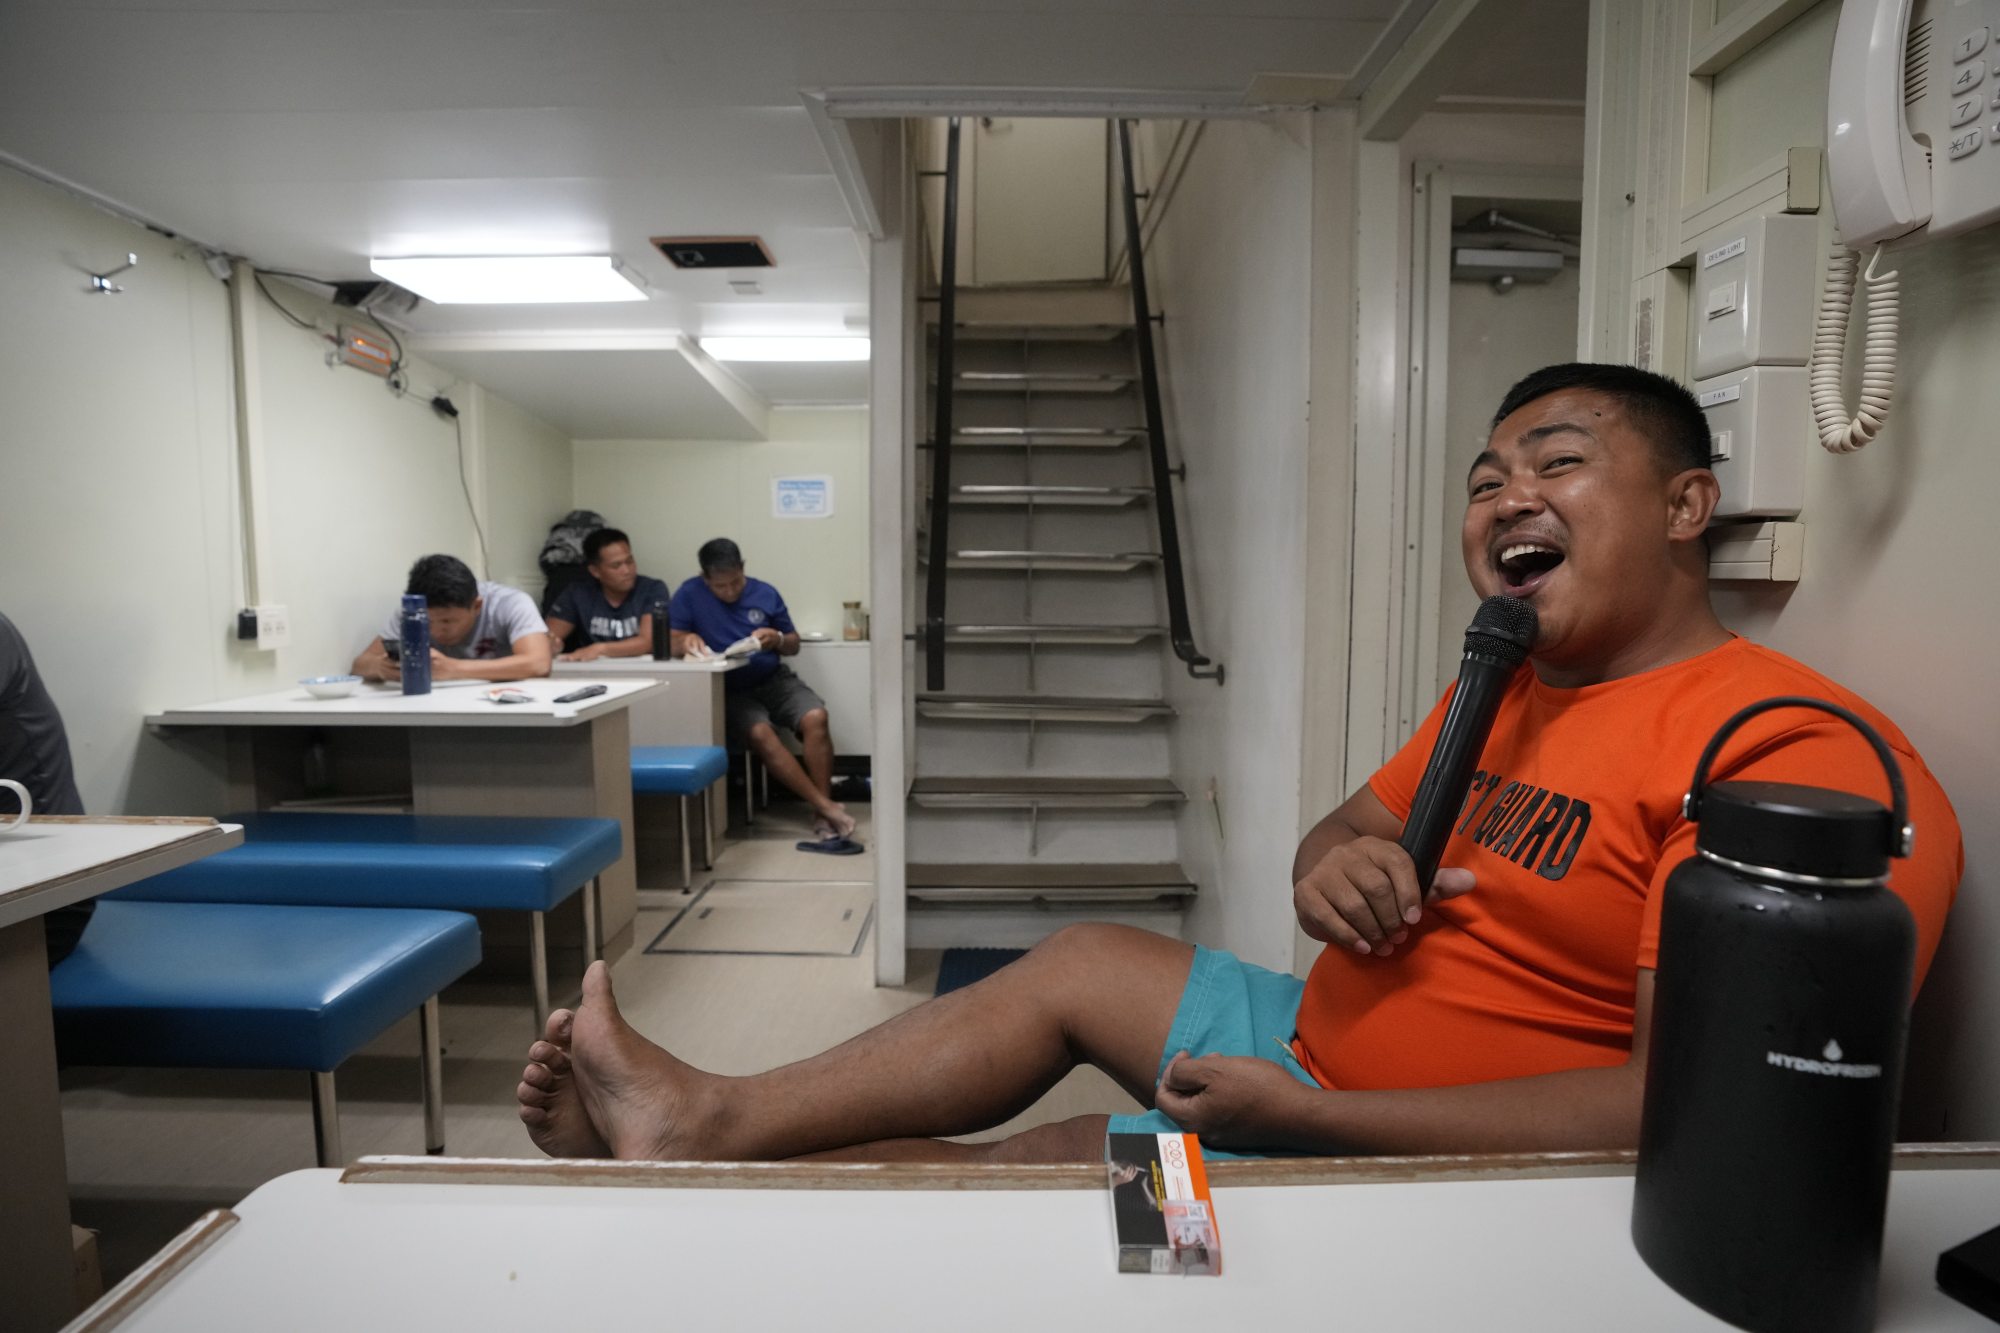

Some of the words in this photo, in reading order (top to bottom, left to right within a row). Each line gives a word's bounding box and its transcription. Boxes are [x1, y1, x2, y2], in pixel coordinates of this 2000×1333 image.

[1961, 38, 1972, 52] 1
[1957, 69, 1972, 85] 4
[1957, 101, 1972, 118] 7
[1713, 391, 1726, 400] FAN
[1473, 780, 1592, 882] GUARD
